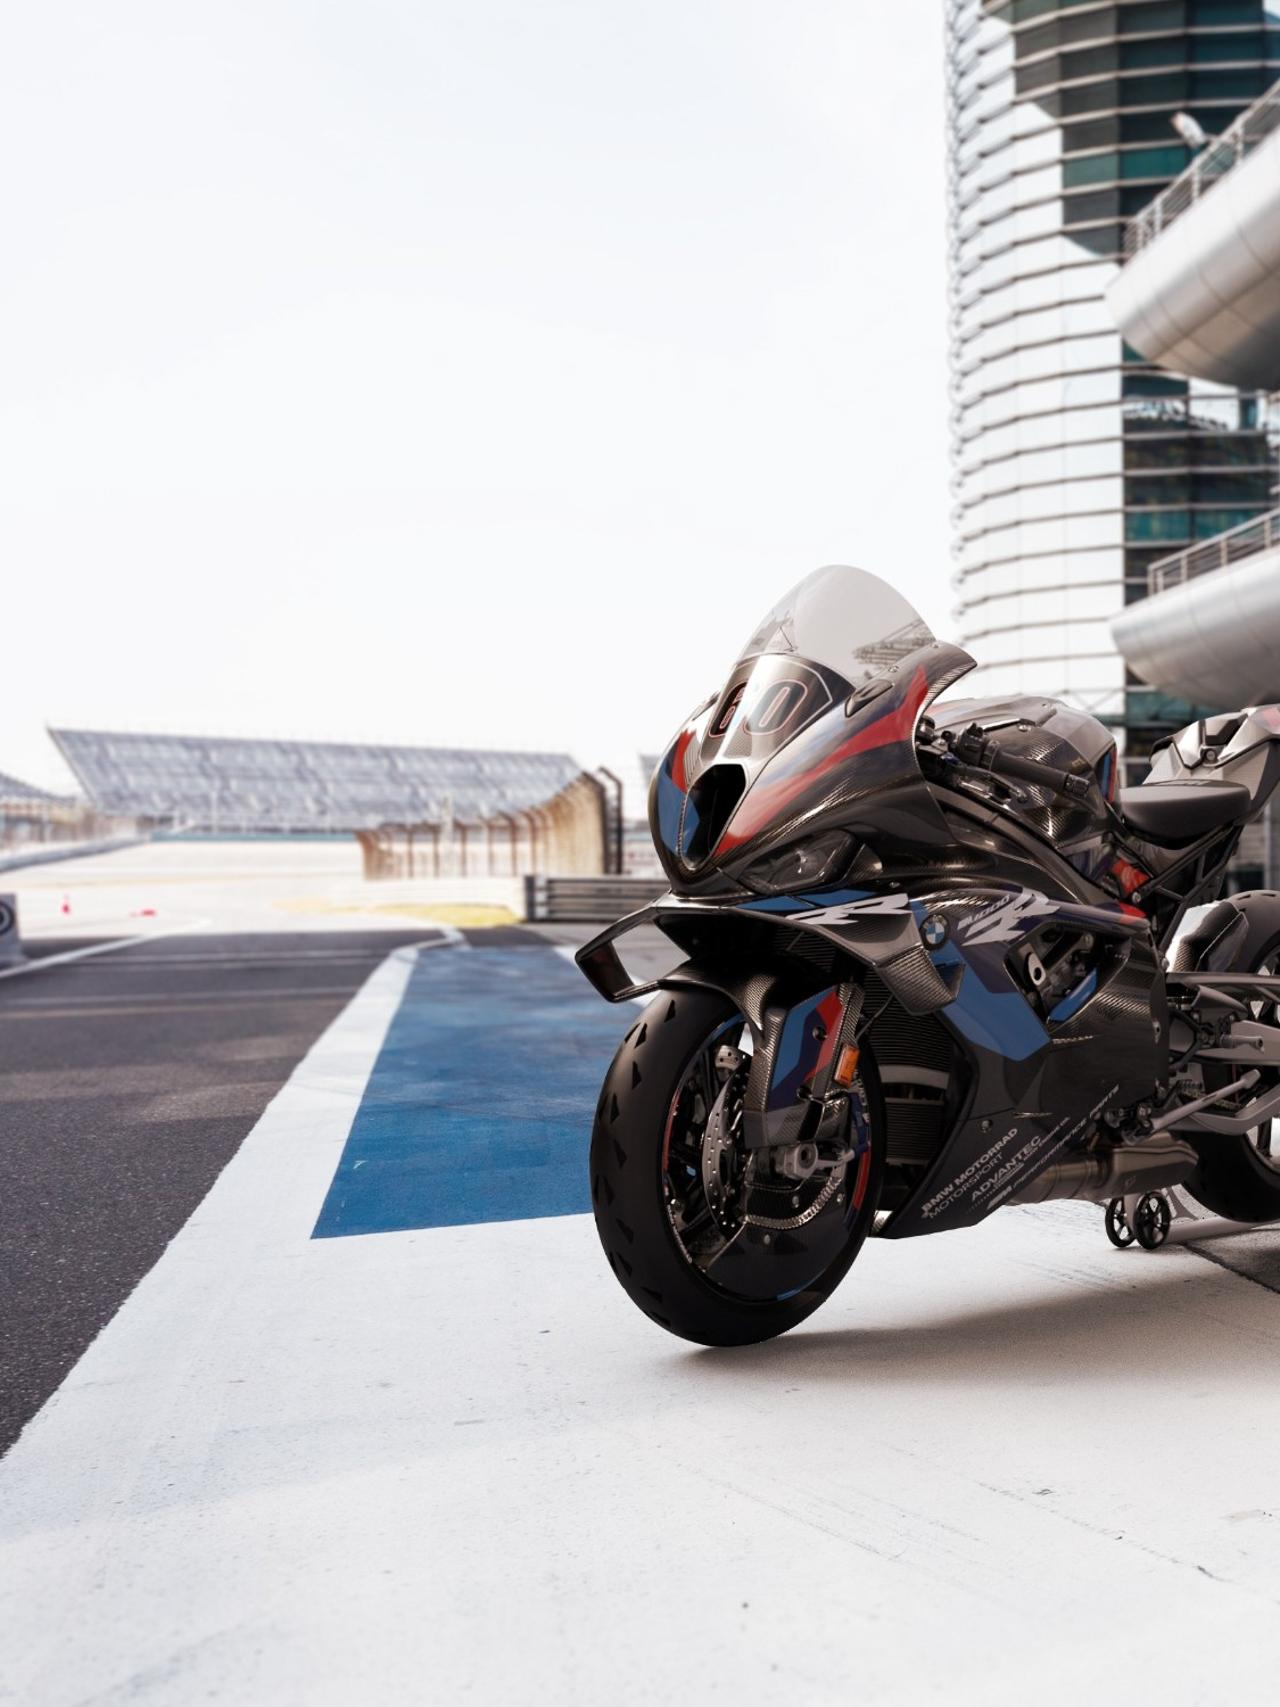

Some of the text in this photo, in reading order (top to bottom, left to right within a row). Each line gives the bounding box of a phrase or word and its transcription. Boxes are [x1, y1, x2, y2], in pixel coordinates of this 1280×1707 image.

[921, 1183, 955, 1213] BMW
[954, 1128, 1018, 1187] MOTORRAD
[928, 1152, 1003, 1218] MOTORSPORT
[971, 1136, 1042, 1201] ADVANTEC
